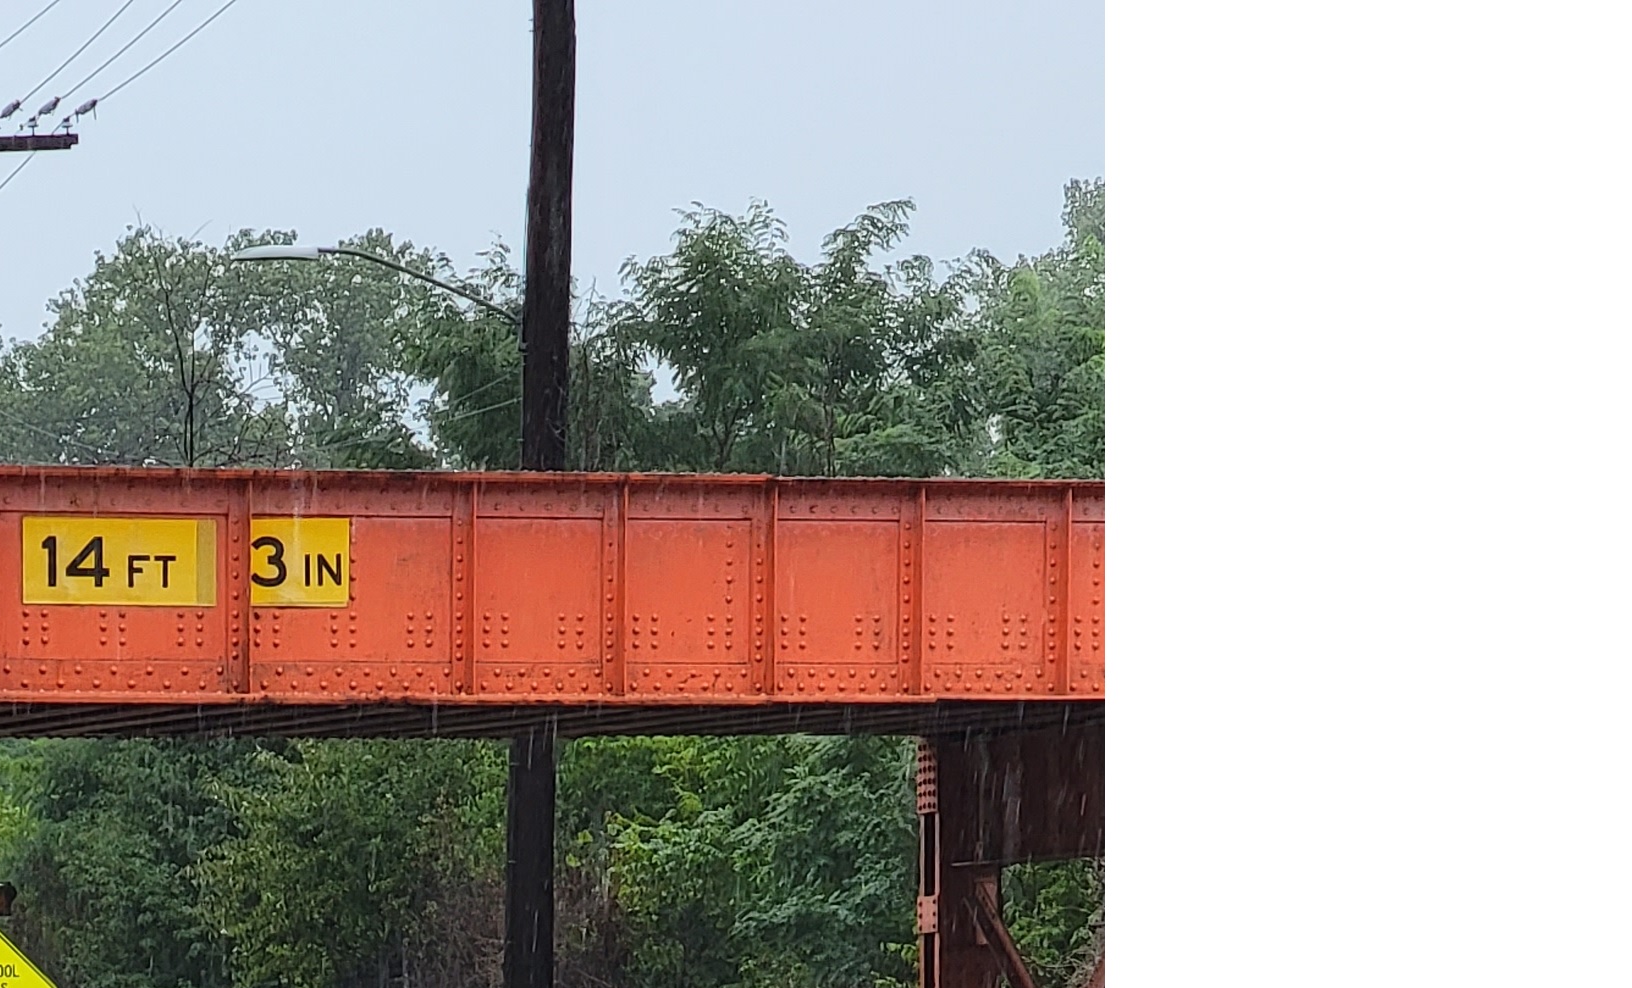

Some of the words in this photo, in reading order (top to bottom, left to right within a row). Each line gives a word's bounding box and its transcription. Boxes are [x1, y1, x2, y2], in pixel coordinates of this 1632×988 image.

[41, 535, 110, 588] 14
[127, 554, 177, 588] FT
[251, 535, 287, 587] 3
[304, 553, 342, 587] IN
